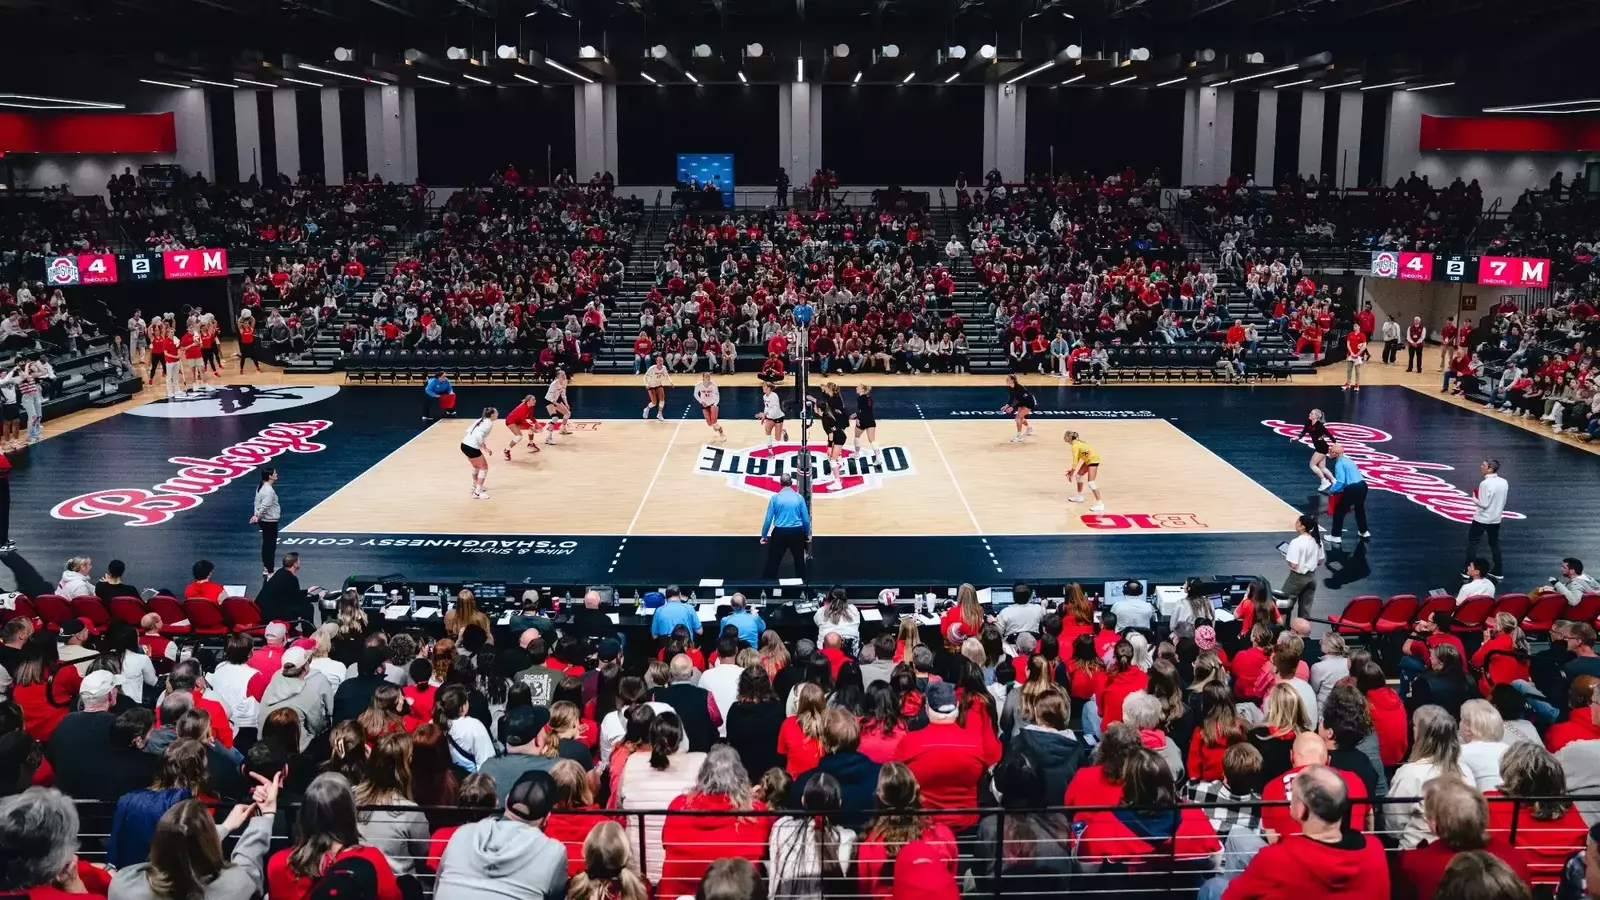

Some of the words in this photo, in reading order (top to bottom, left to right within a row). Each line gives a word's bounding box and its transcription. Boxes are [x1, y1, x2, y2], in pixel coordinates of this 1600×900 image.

[88, 258, 107, 274] 4
[136, 261, 147, 271] 2
[173, 254, 190, 269] 7
[202, 251, 223, 271] M
[1406, 257, 1424, 271] 4
[1450, 263, 1461, 273] 2
[1489, 261, 1507, 276] 7
[1520, 261, 1545, 282] M
[50, 419, 333, 526] Buckeyes
[360, 538, 578, 548] O'SHAUGHNESSY
[461, 547, 514, 555] Shyan
[534, 548, 575, 556] Mike
